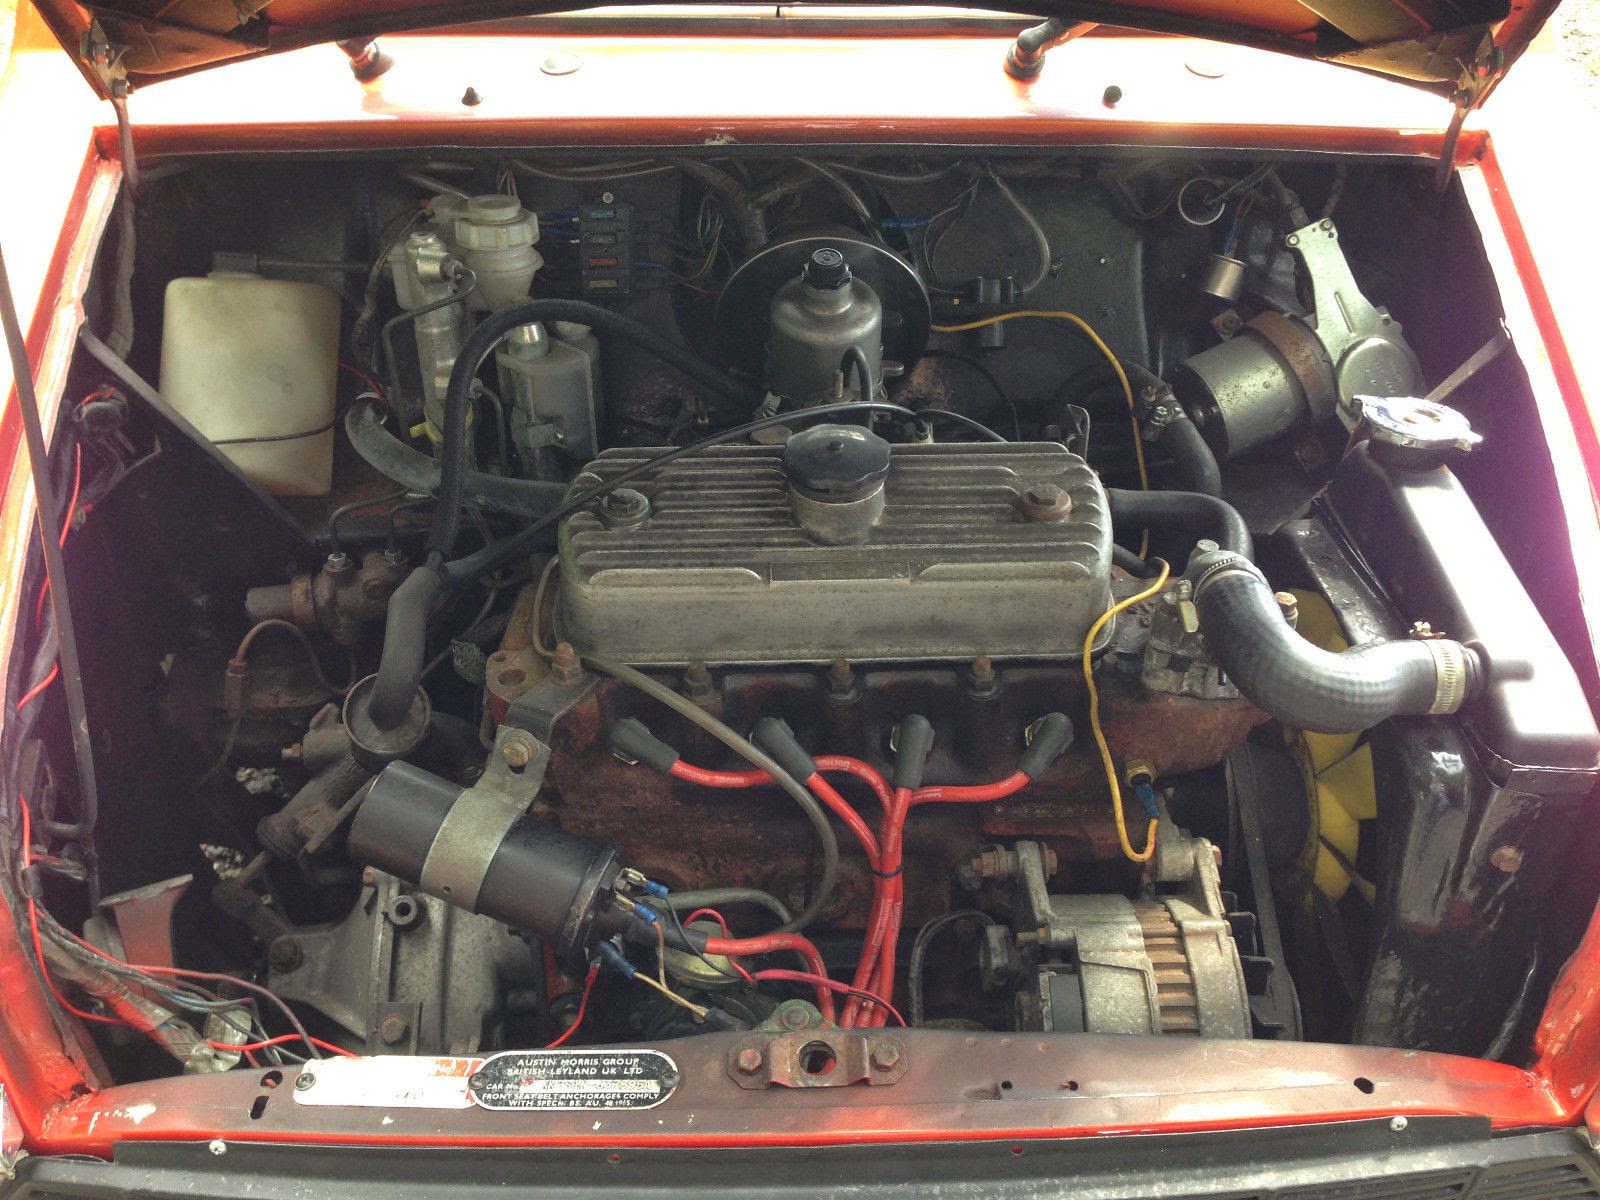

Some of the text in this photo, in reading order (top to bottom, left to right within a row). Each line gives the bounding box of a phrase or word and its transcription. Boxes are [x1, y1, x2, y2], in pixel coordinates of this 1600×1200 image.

[517, 1057, 640, 1066] AUSTIN MORRIS GROUP
[506, 1067, 644, 1076] BRITISH LEYLAND UK LTD
[481, 1093, 513, 1101] FRONT
[623, 1092, 660, 1100] COMPLY
